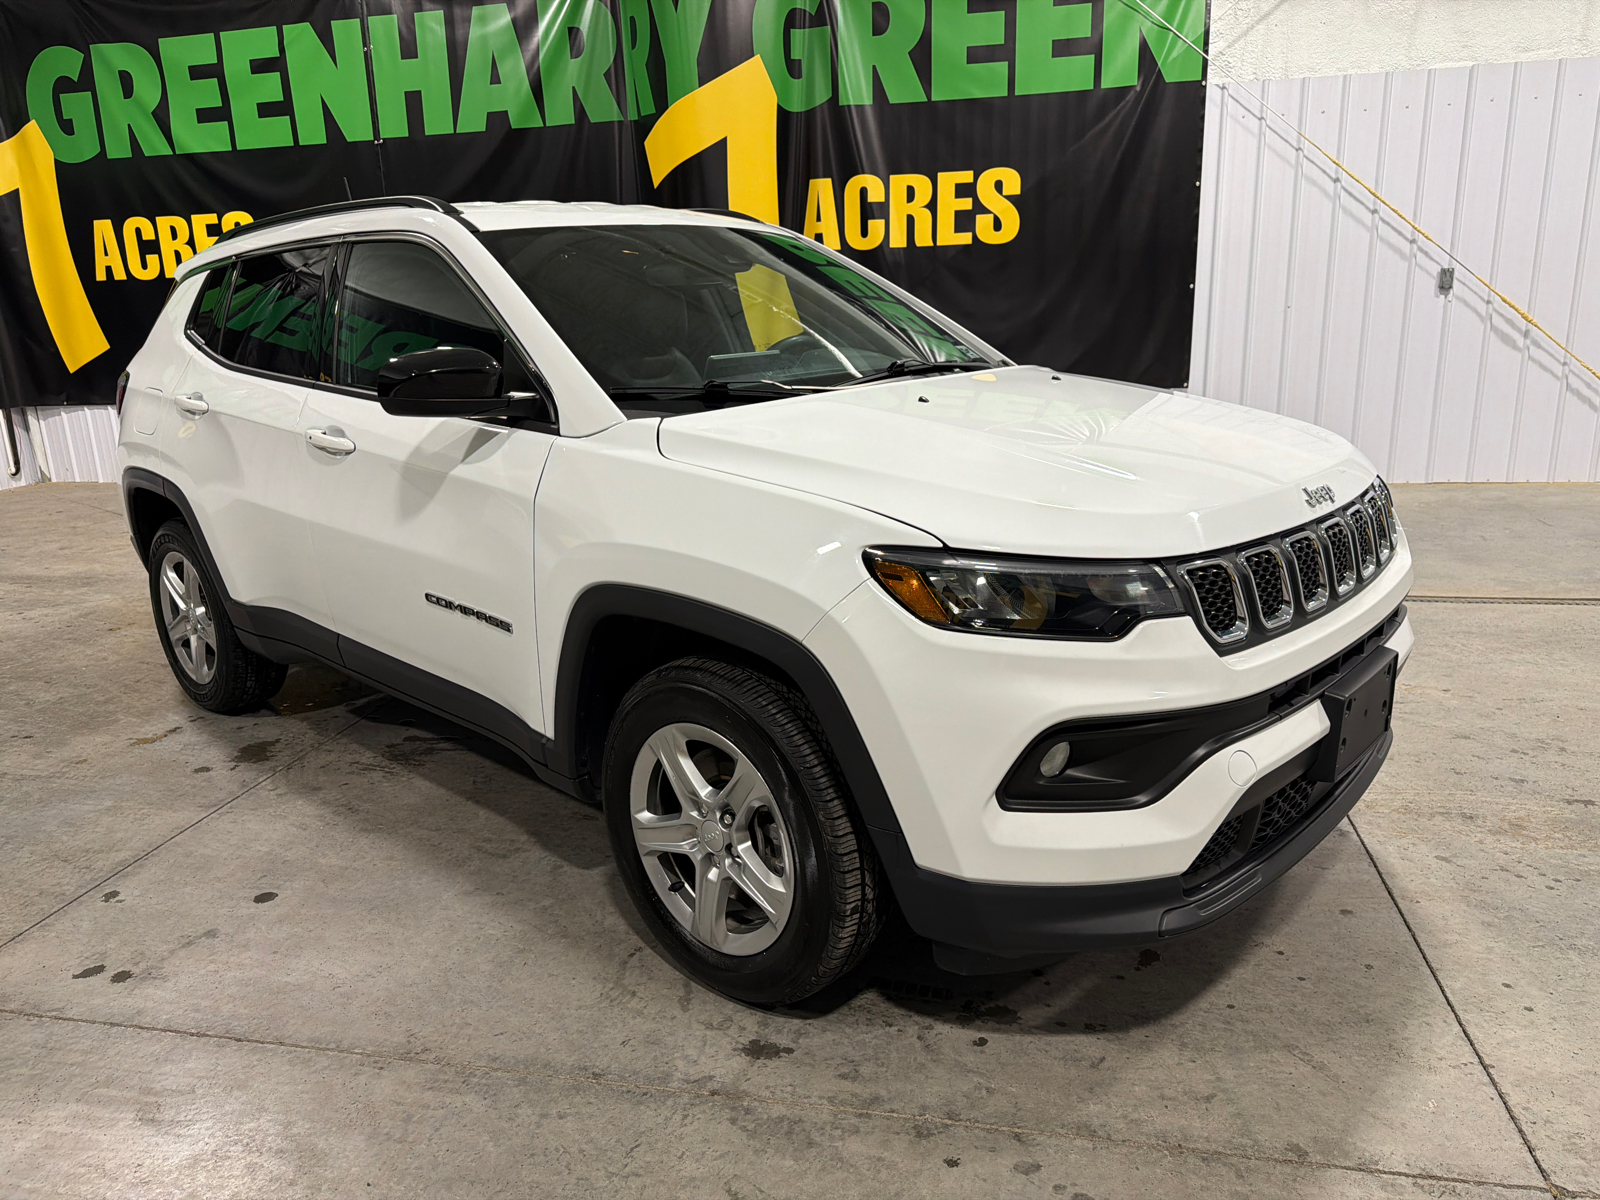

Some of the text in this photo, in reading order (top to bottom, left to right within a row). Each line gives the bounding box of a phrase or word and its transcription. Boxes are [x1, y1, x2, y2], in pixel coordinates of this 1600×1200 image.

[26, 18, 374, 163] GREEN
[367, 0, 1204, 138] HARRY GREEN
[644, 54, 1021, 250] 1 ACRES
[1301, 483, 1336, 508] Jeep
[424, 591, 513, 635] COMPASS
